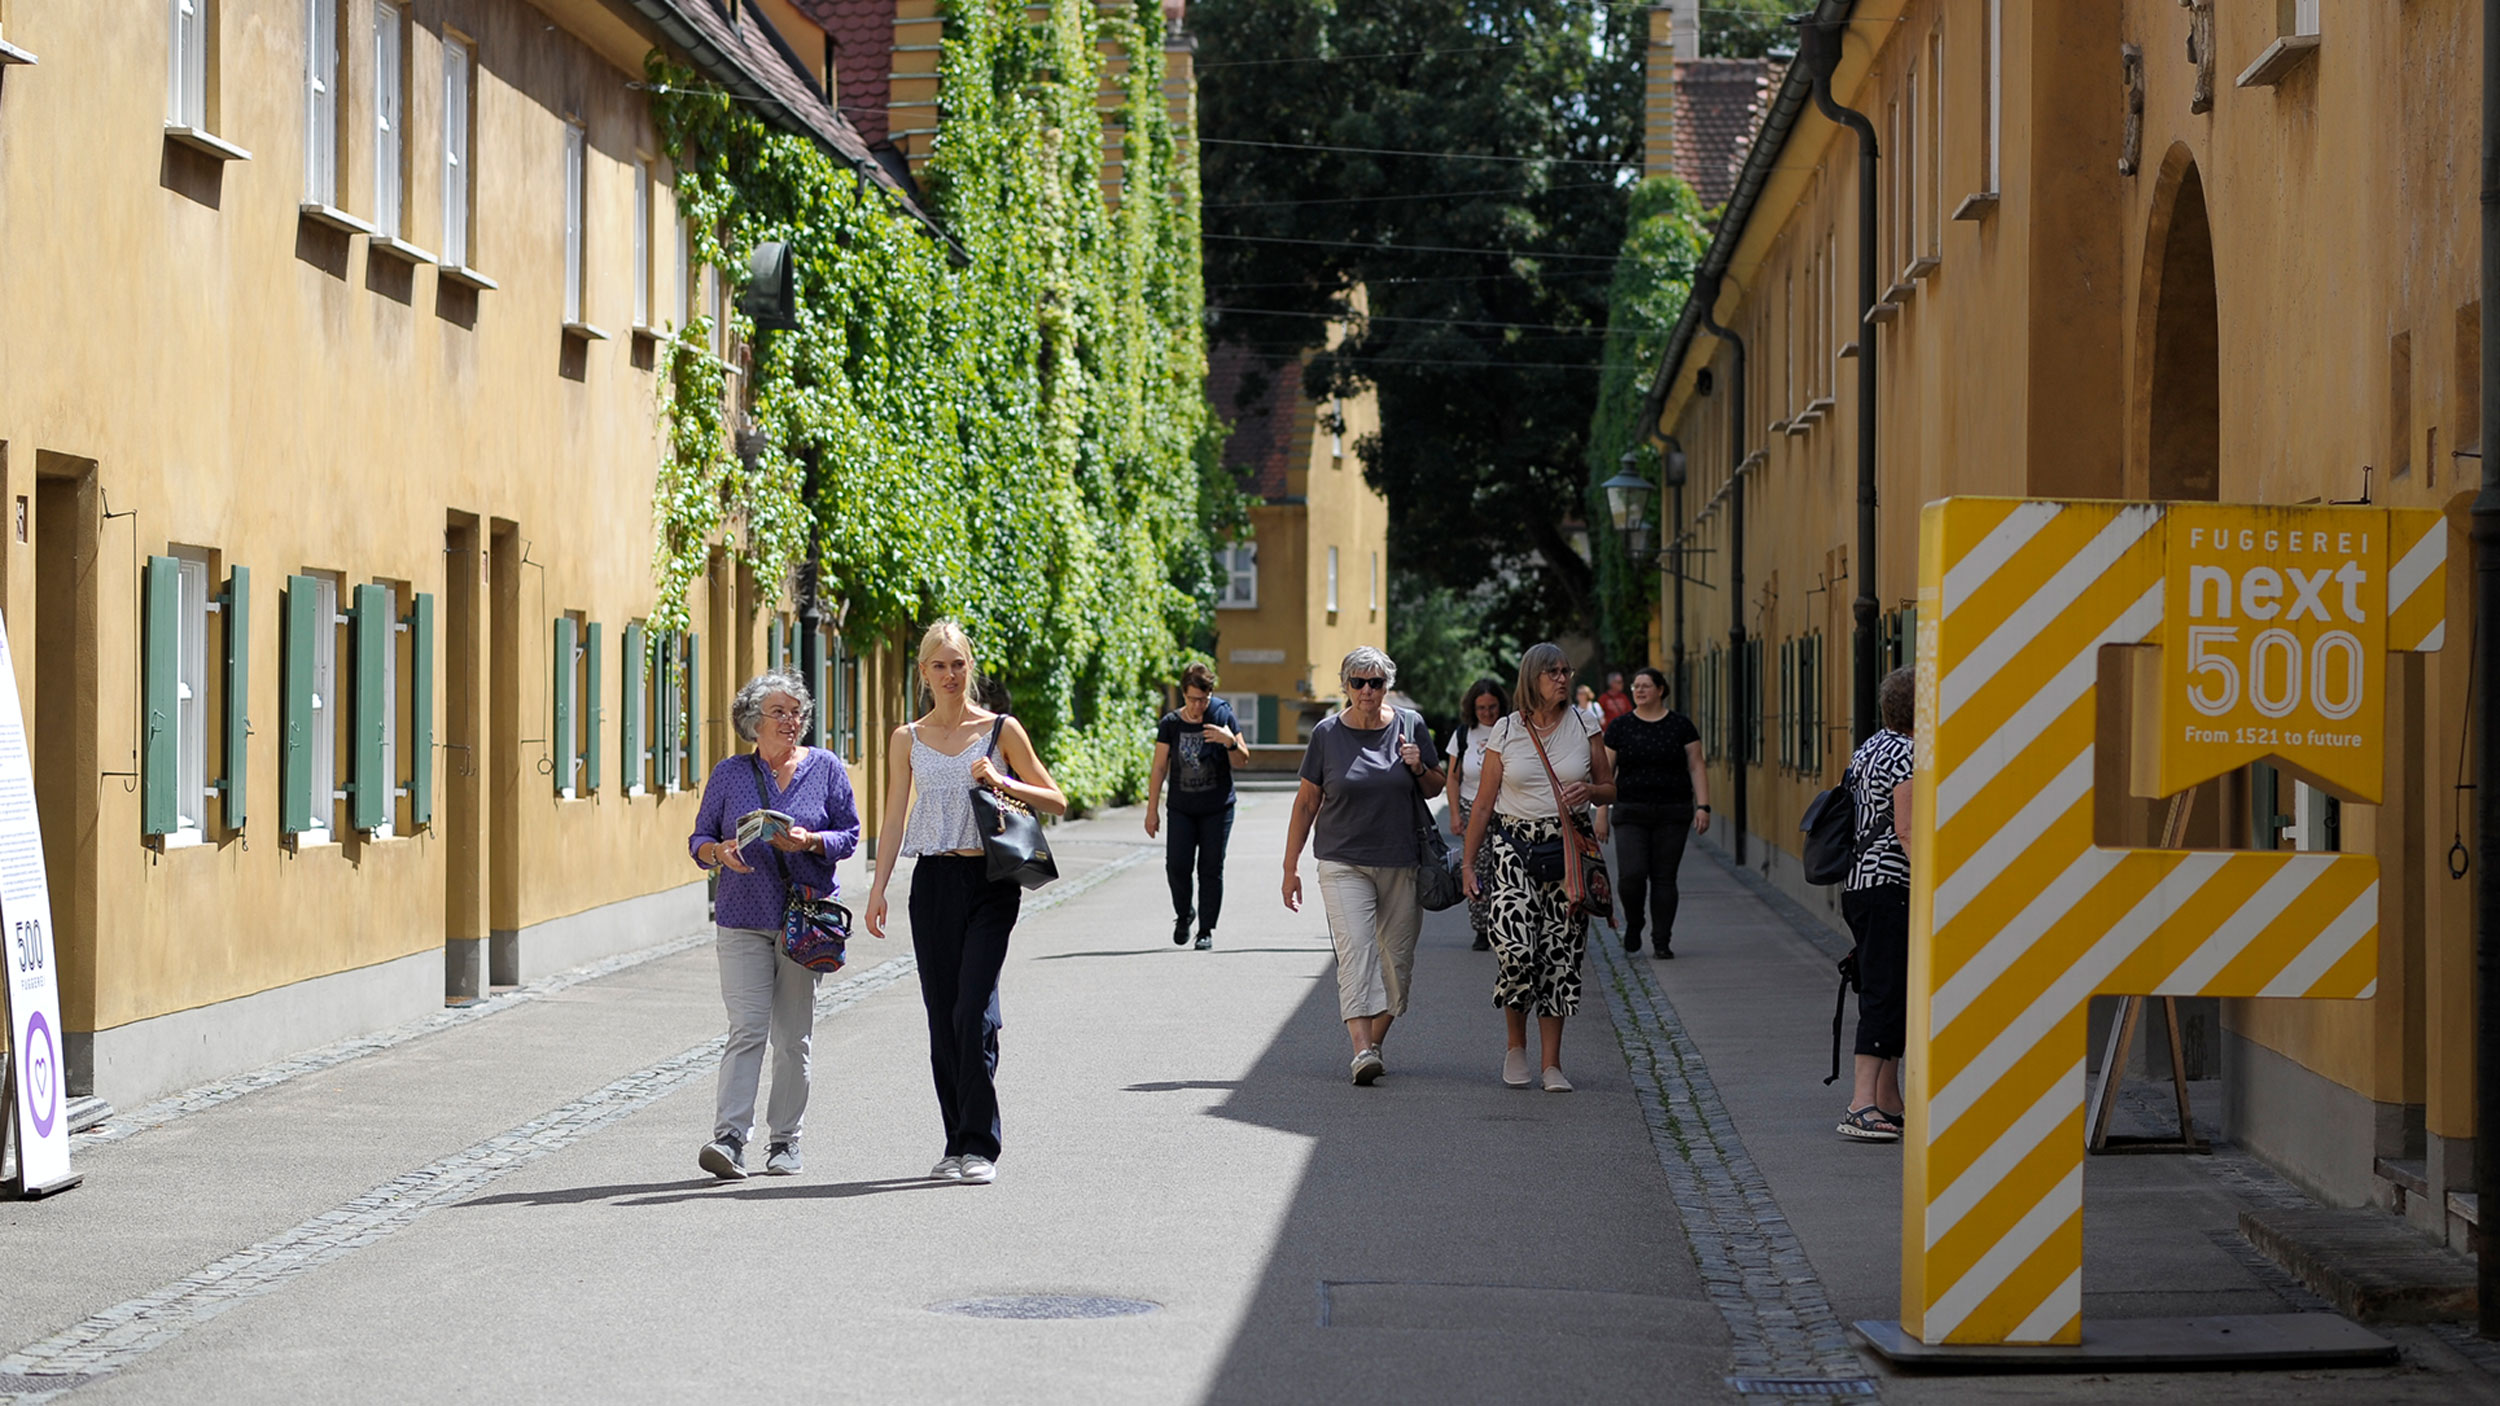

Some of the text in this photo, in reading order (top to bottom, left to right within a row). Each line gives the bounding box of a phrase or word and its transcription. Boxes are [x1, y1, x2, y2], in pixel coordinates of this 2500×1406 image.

[2190, 528, 2368, 554] FUGGEREI
[2189, 560, 2367, 623] next
[2187, 625, 2364, 720] 500
[2185, 726, 2362, 747] From 1521 to future
[15, 918, 44, 973] 500
